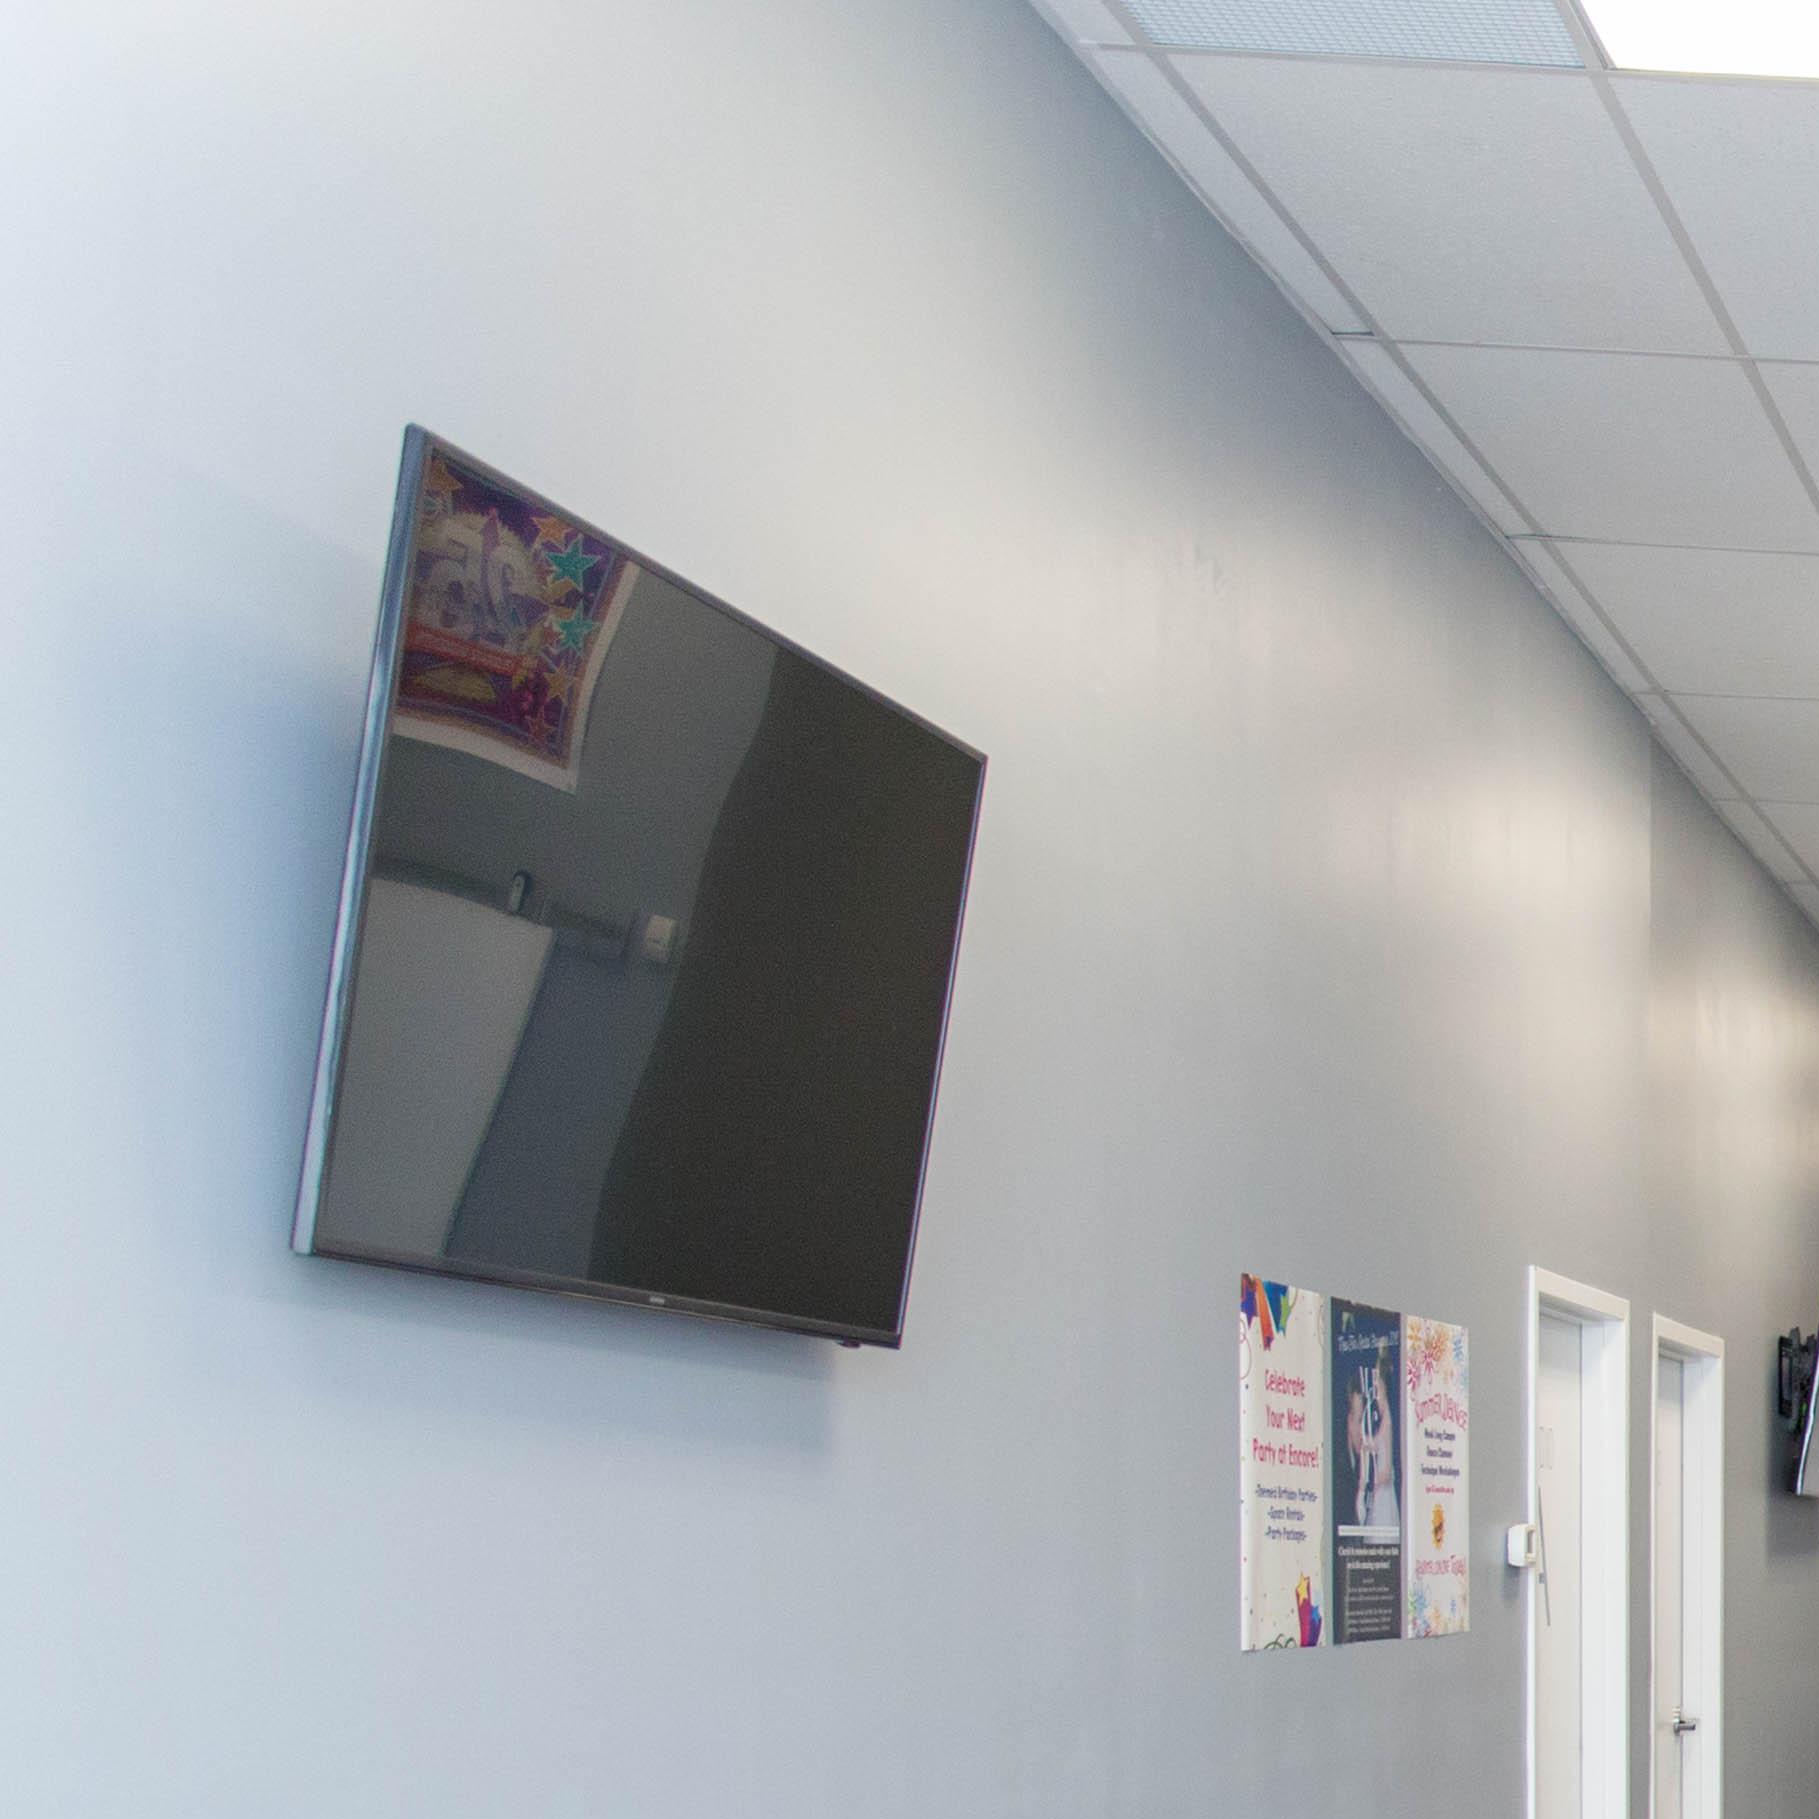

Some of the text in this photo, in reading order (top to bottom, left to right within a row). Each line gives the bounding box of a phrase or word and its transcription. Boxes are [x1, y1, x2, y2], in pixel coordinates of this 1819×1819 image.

[1265, 1369, 1305, 1397] Celebrate
[1265, 1404, 1305, 1432] Your Next
[1253, 1438, 1277, 1466] Party
[1289, 1444, 1319, 1469] Encore!
